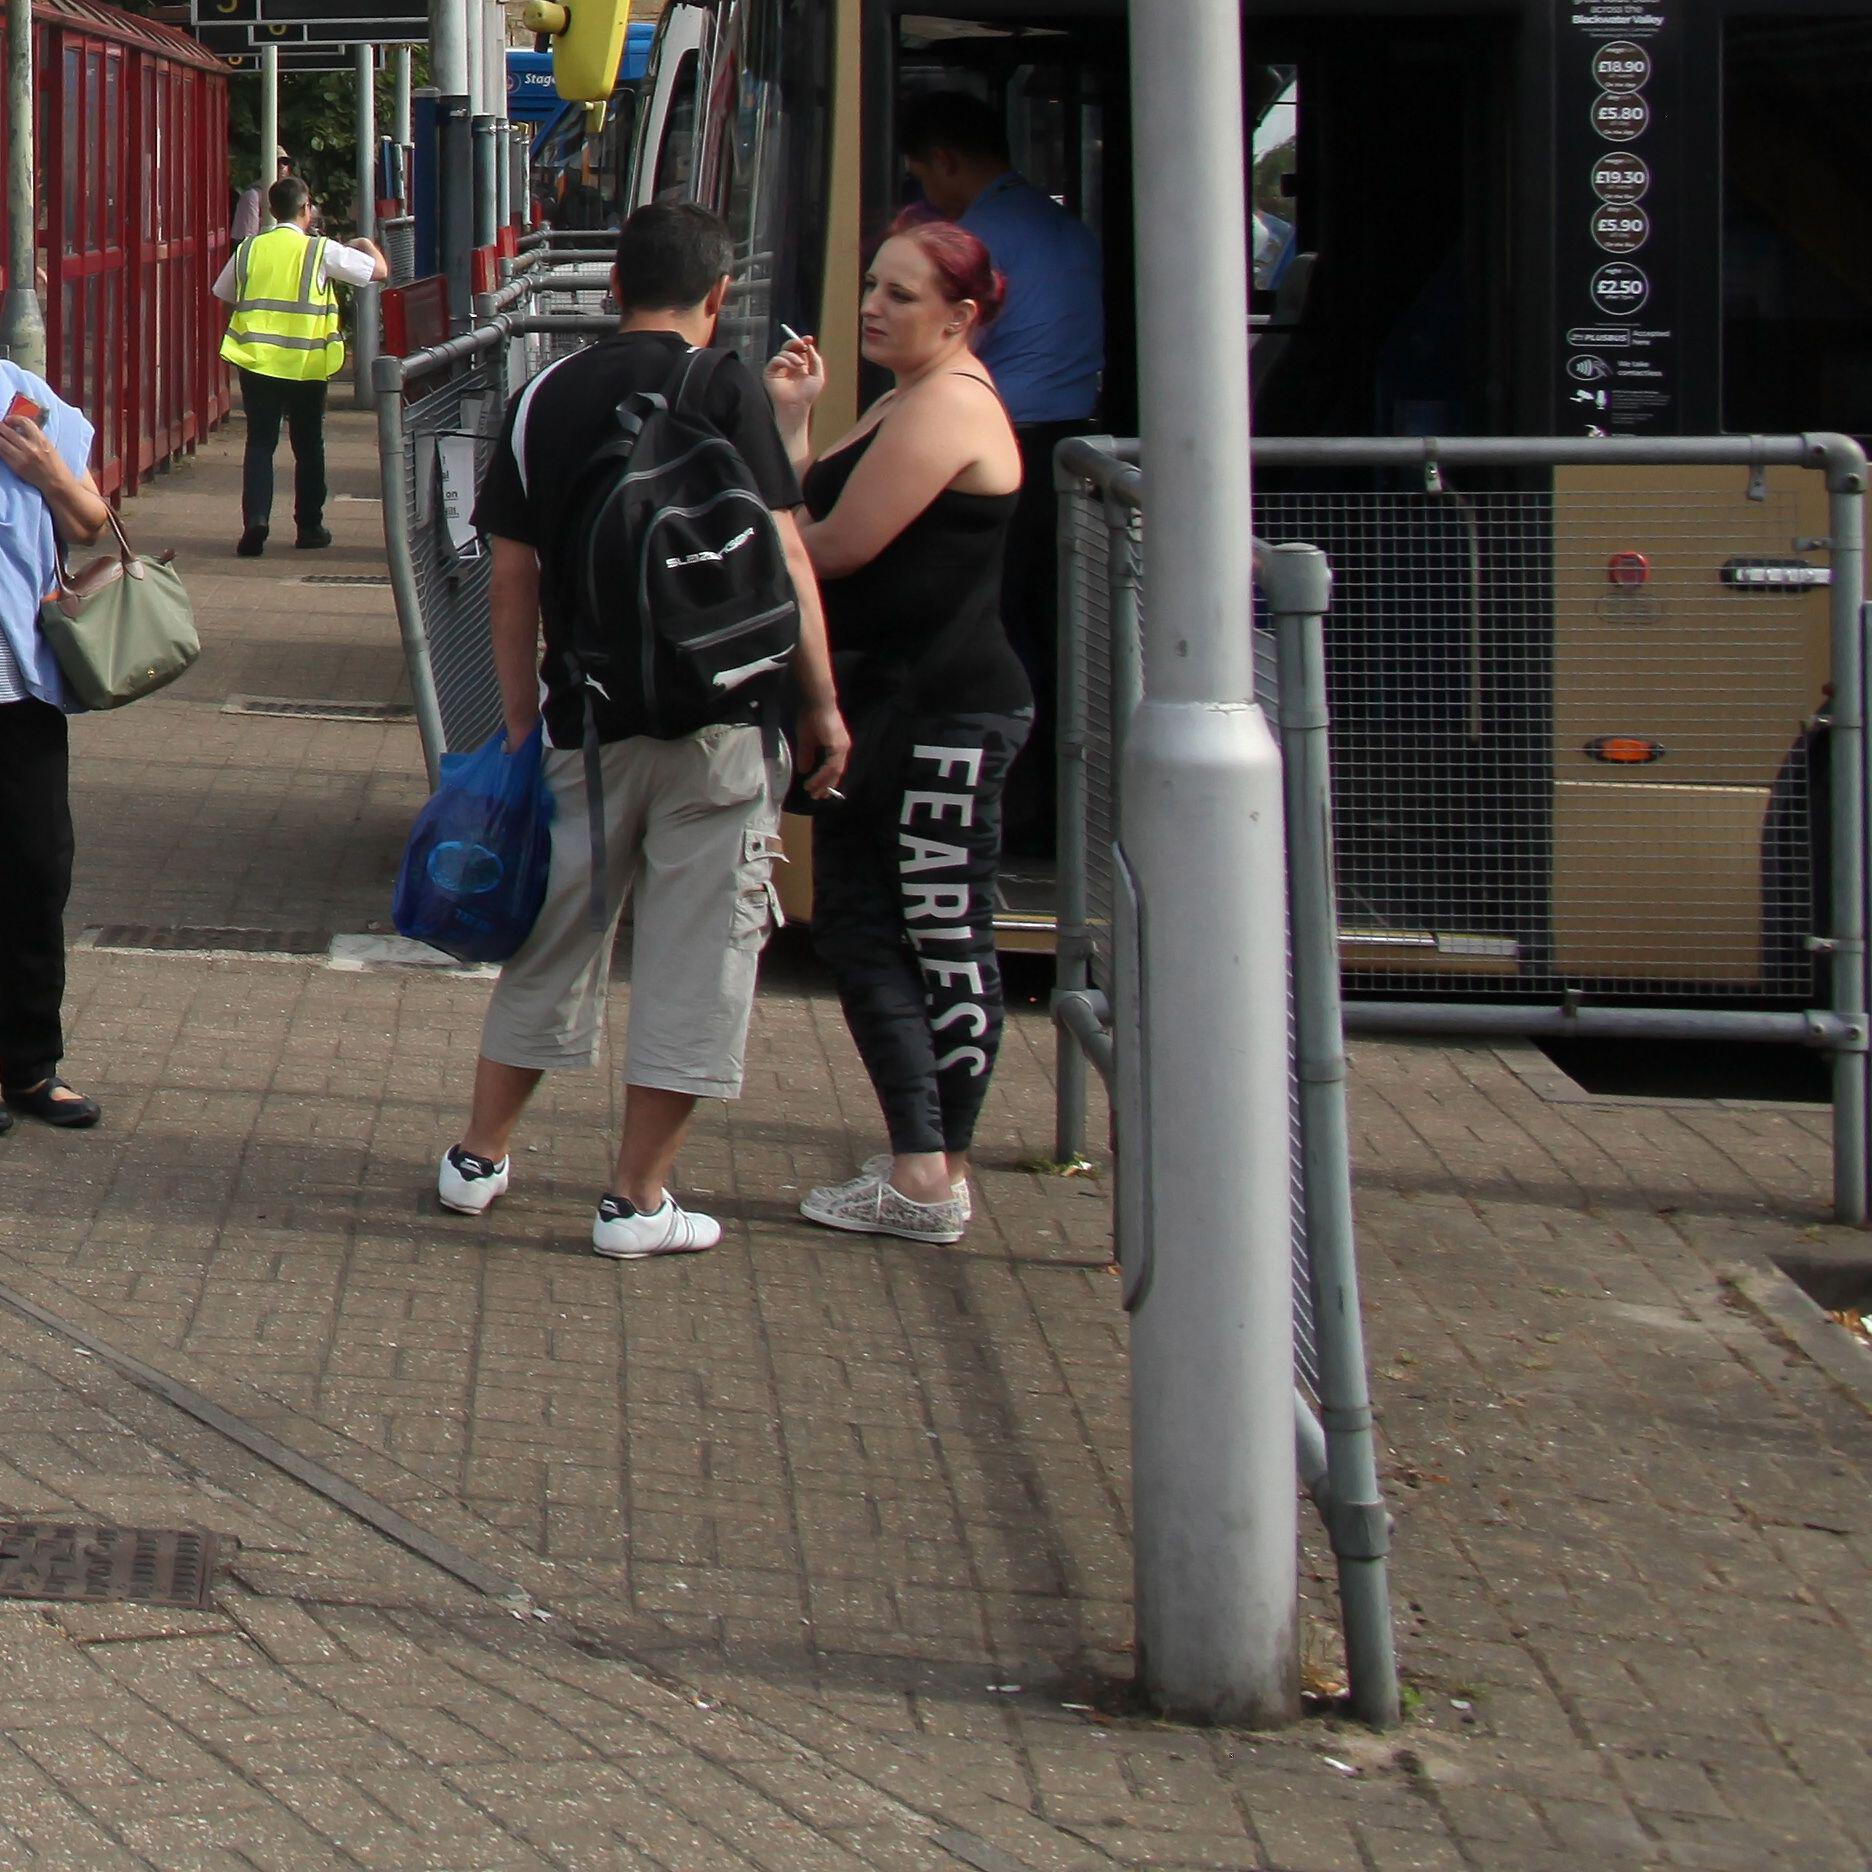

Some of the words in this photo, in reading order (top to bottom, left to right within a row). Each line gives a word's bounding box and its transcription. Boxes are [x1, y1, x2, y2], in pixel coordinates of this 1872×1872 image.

[1572, 15, 1631, 24] Blackwater
[1632, 14, 1664, 26] Valley
[1598, 60, 1645, 73] £18.90
[1597, 107, 1644, 120] £5.80
[1594, 171, 1646, 184] £19.30
[1597, 219, 1644, 232] £5.90
[1596, 280, 1643, 294] £2.50
[899, 744, 988, 1078] FEARLESS
